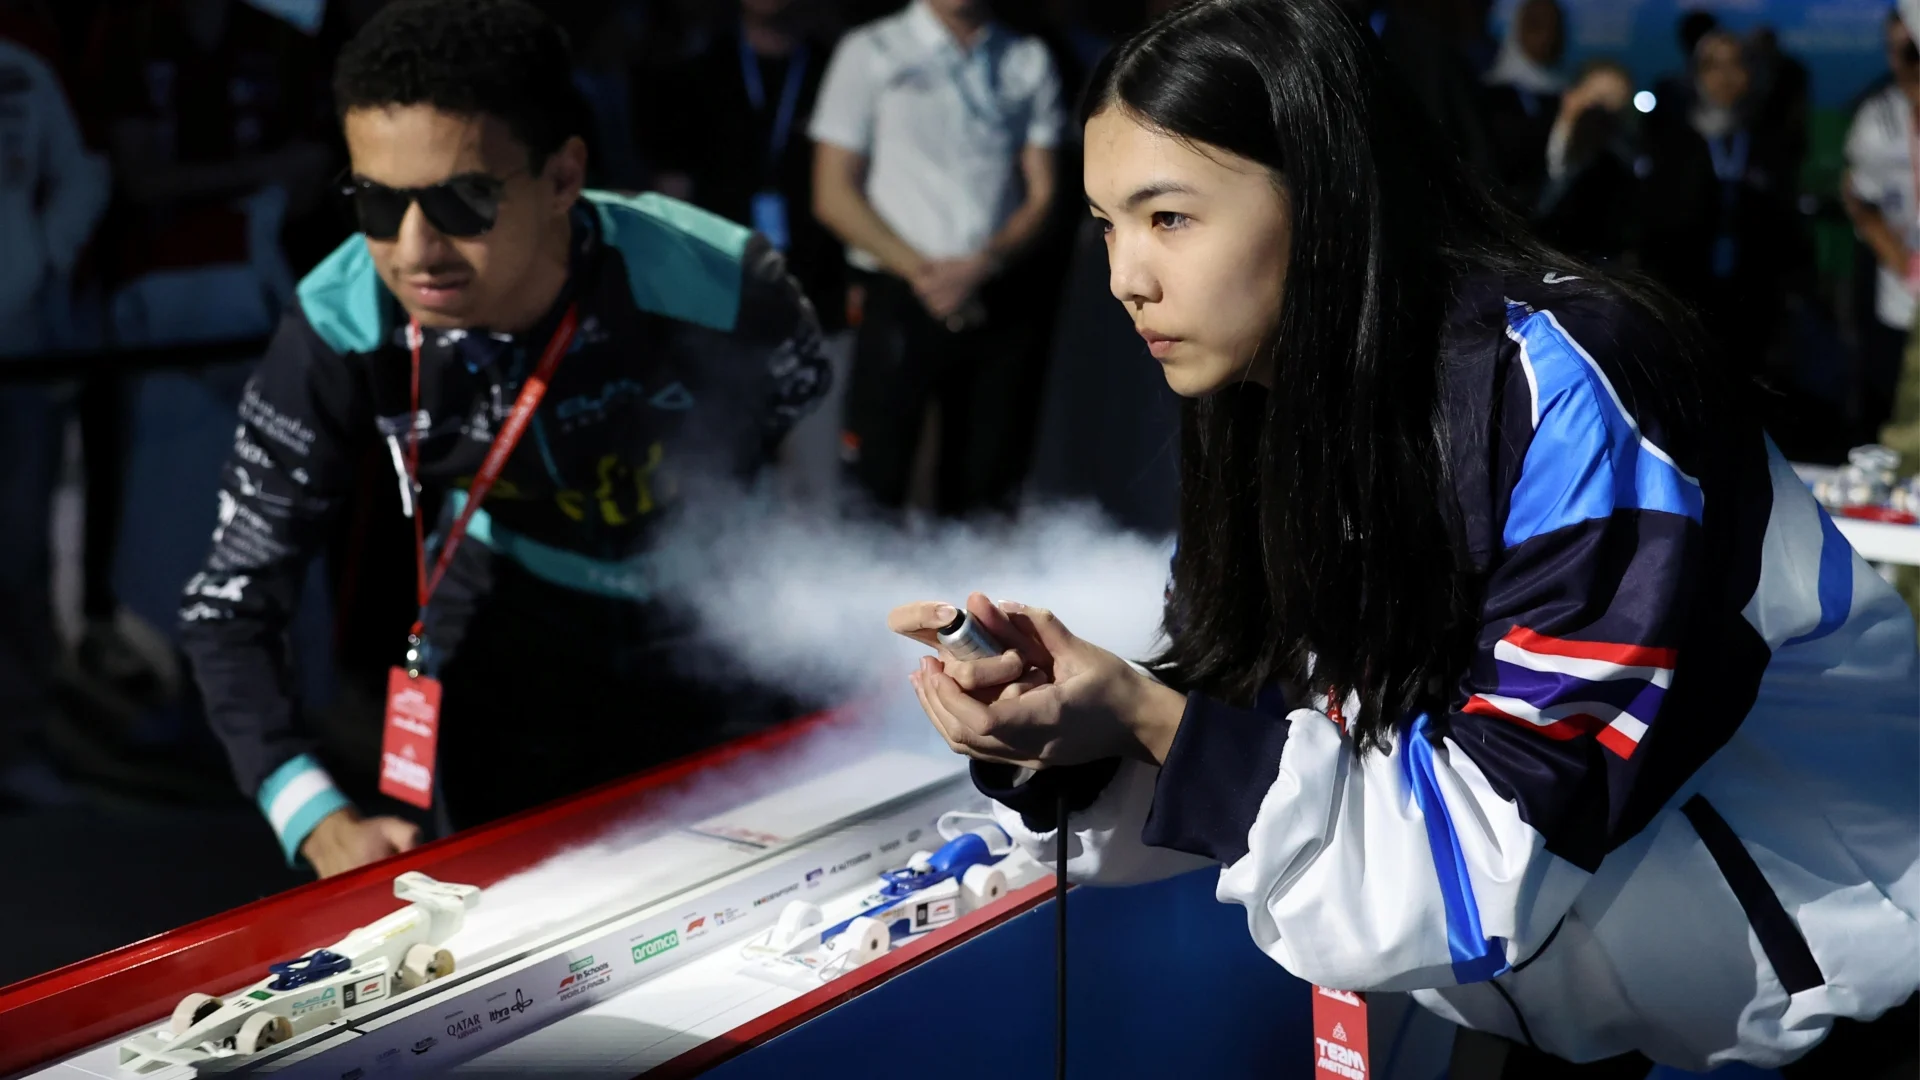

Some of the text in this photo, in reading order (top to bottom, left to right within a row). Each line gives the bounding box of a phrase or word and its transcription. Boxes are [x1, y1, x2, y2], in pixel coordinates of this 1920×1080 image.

[633, 932, 678, 961] aramco
[583, 961, 609, 978] Schools
[560, 983, 586, 1002] WORLD
[446, 1013, 481, 1037] QATAR
[1315, 1036, 1366, 1072] TEAM
[1317, 1056, 1365, 1080] MEMBER
